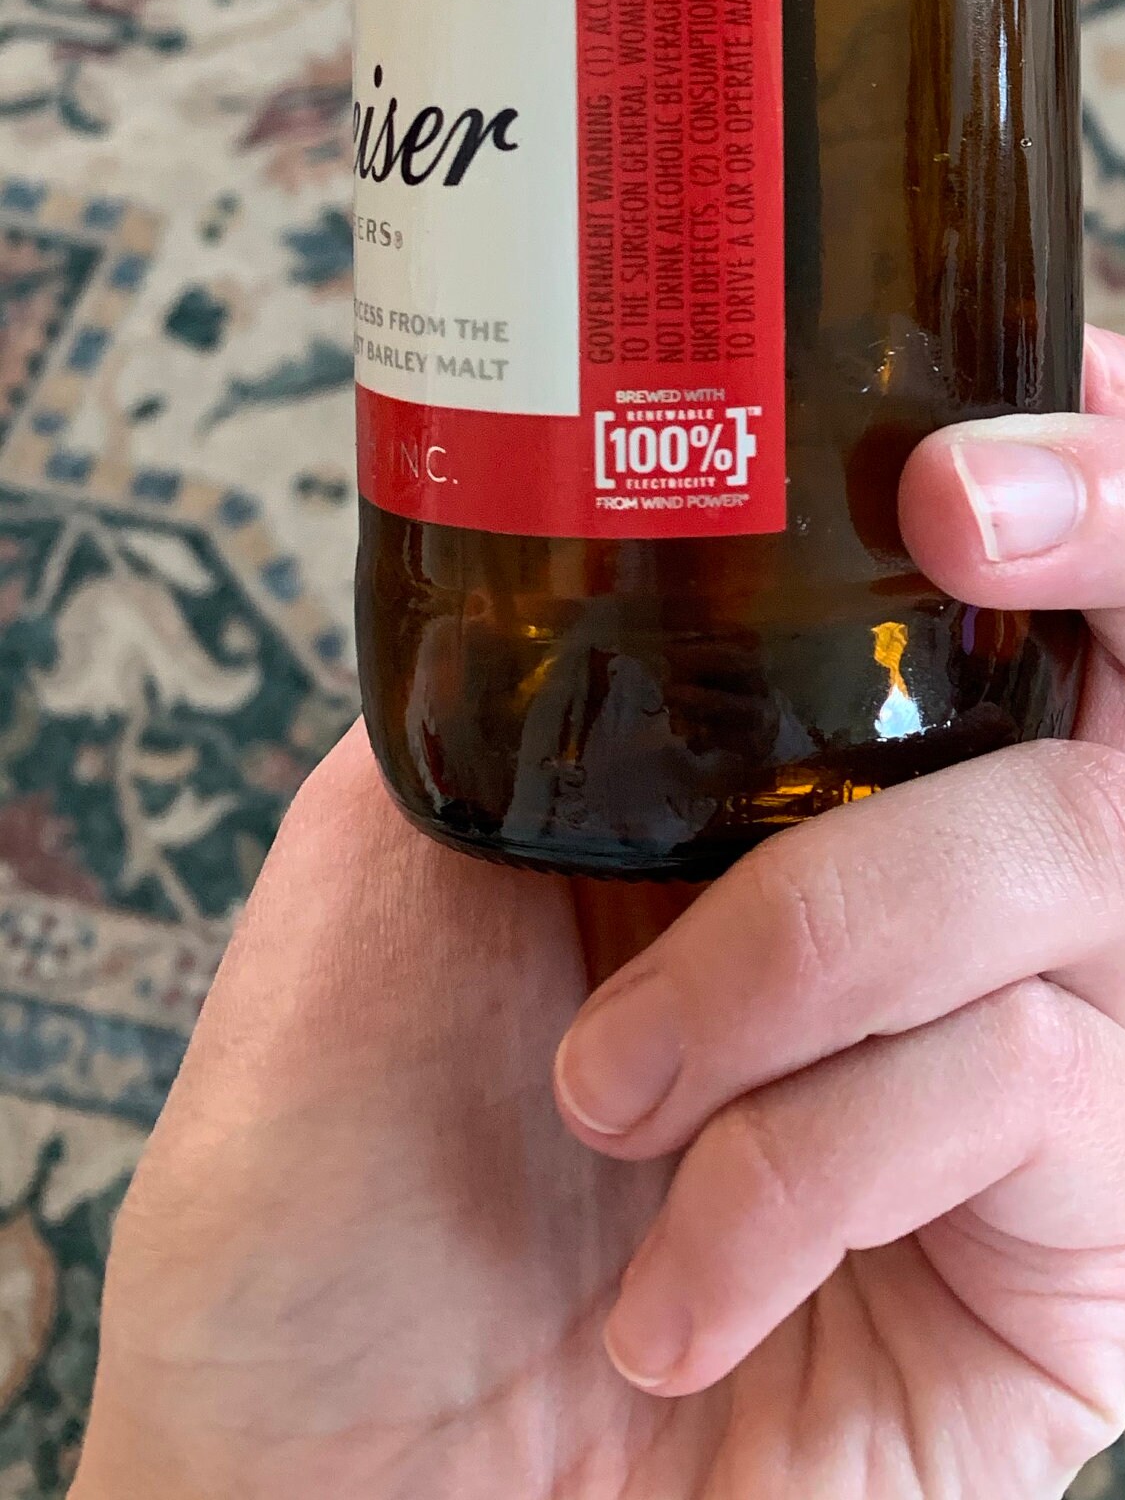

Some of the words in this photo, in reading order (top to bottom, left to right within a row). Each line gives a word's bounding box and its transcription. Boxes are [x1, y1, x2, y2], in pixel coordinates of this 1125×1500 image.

[724, 34, 754, 134] OPERATE
[655, 115, 684, 236] ALCOHOLIC
[688, 155, 720, 186] (2)
[725, 143, 755, 174] OR
[725, 183, 755, 226] CAR
[621, 181, 649, 284] SURGEON
[726, 233, 755, 248] A
[587, 211, 615, 364] GOVERNMENT
[657, 243, 685, 311] DRINK
[726, 257, 755, 324] DRIVE
[389, 310, 446, 338] FROM
[454, 318, 510, 343] THE
[621, 292, 649, 328] THE
[621, 337, 650, 363] TO
[657, 321, 686, 363] NOT
[690, 301, 721, 363] BIRTH
[726, 332, 755, 360] TO
[367, 340, 428, 373] BARLEY
[437, 355, 510, 381] MALT
[615, 389, 682, 404] BREWED
[684, 388, 726, 402] WITH
[626, 408, 715, 422] RENEWABLE
[609, 422, 734, 474] 100%
[626, 475, 716, 490] ELECTRICITY
[595, 495, 639, 510] FROM
[641, 494, 684, 510] WIND
